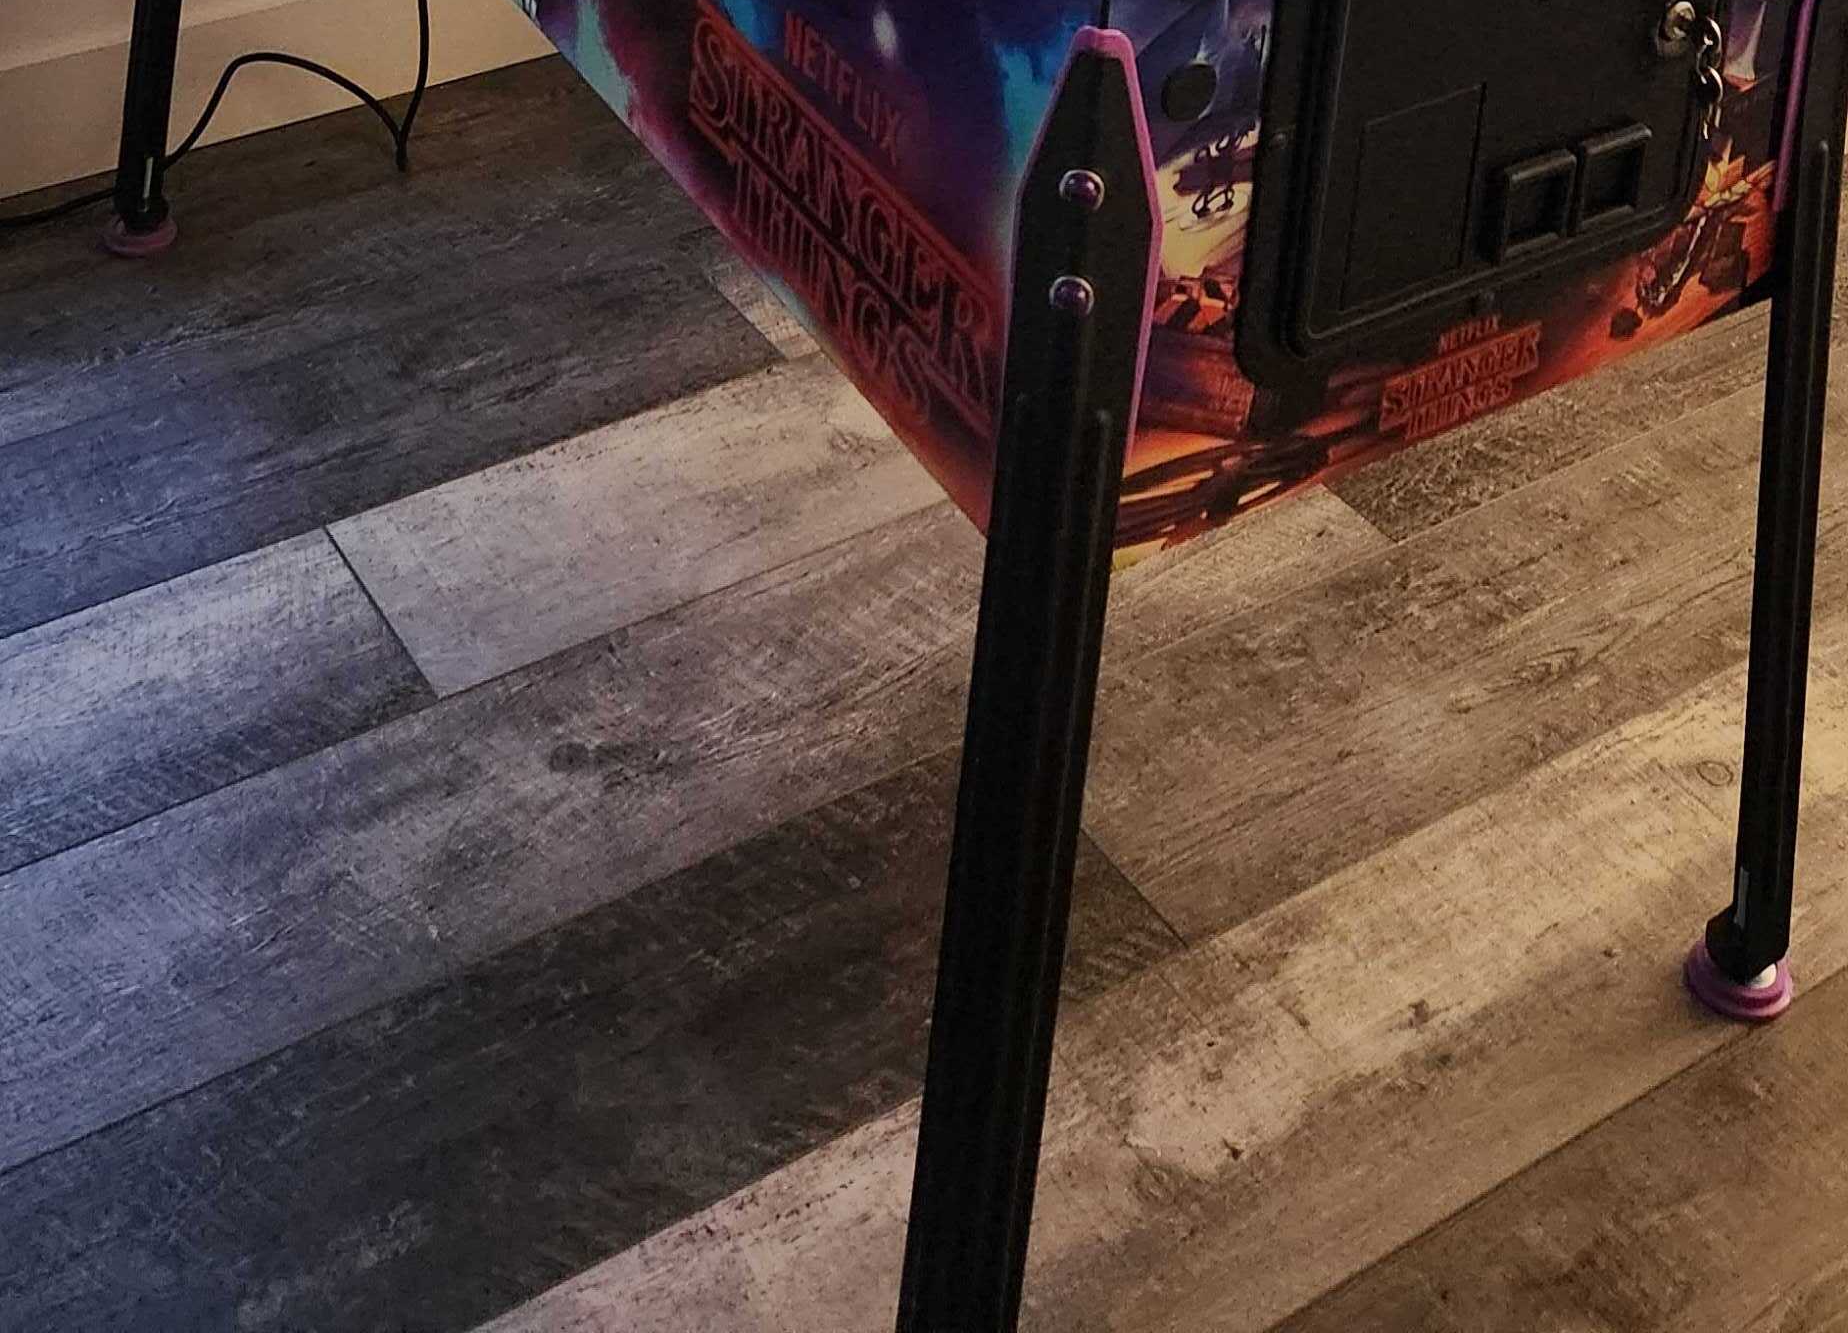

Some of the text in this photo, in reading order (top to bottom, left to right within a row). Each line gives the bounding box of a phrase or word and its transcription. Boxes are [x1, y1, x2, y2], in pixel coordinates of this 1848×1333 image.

[784, 9, 901, 165] NETFLIX
[691, 18, 990, 411] STRANGER
[732, 149, 934, 423] THINGS
[1437, 313, 1499, 355] NETFLIX
[1380, 326, 1540, 430] STRANGER
[1404, 371, 1513, 441] THINGS
